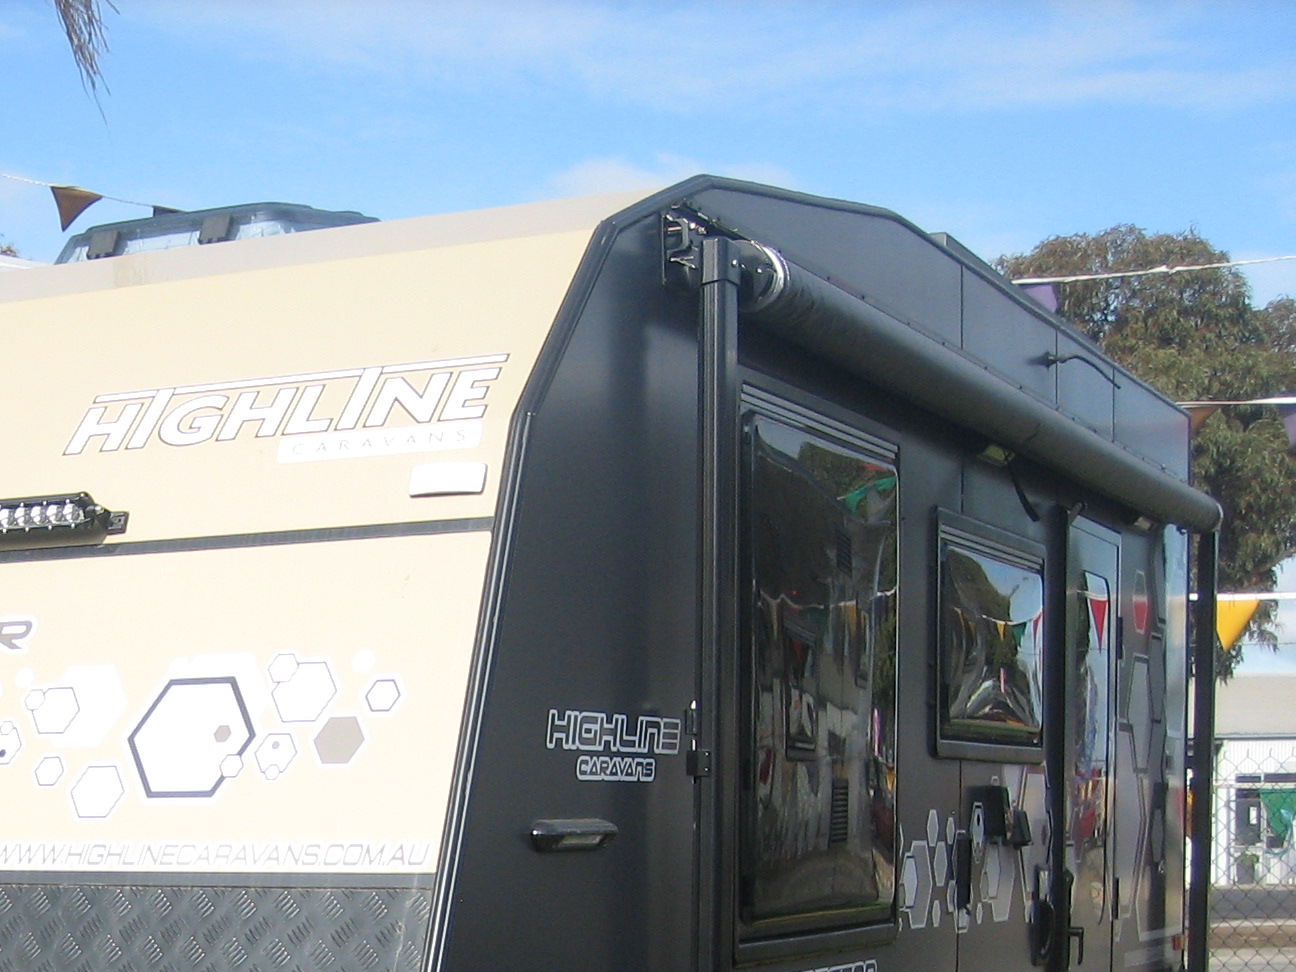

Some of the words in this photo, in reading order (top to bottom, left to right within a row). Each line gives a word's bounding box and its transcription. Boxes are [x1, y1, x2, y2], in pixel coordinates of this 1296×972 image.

[62, 353, 510, 456] HIGHLINE
[292, 429, 467, 456] CARAVANS
[546, 709, 681, 754] HIGHLINE
[576, 756, 655, 781] CARAVANS
